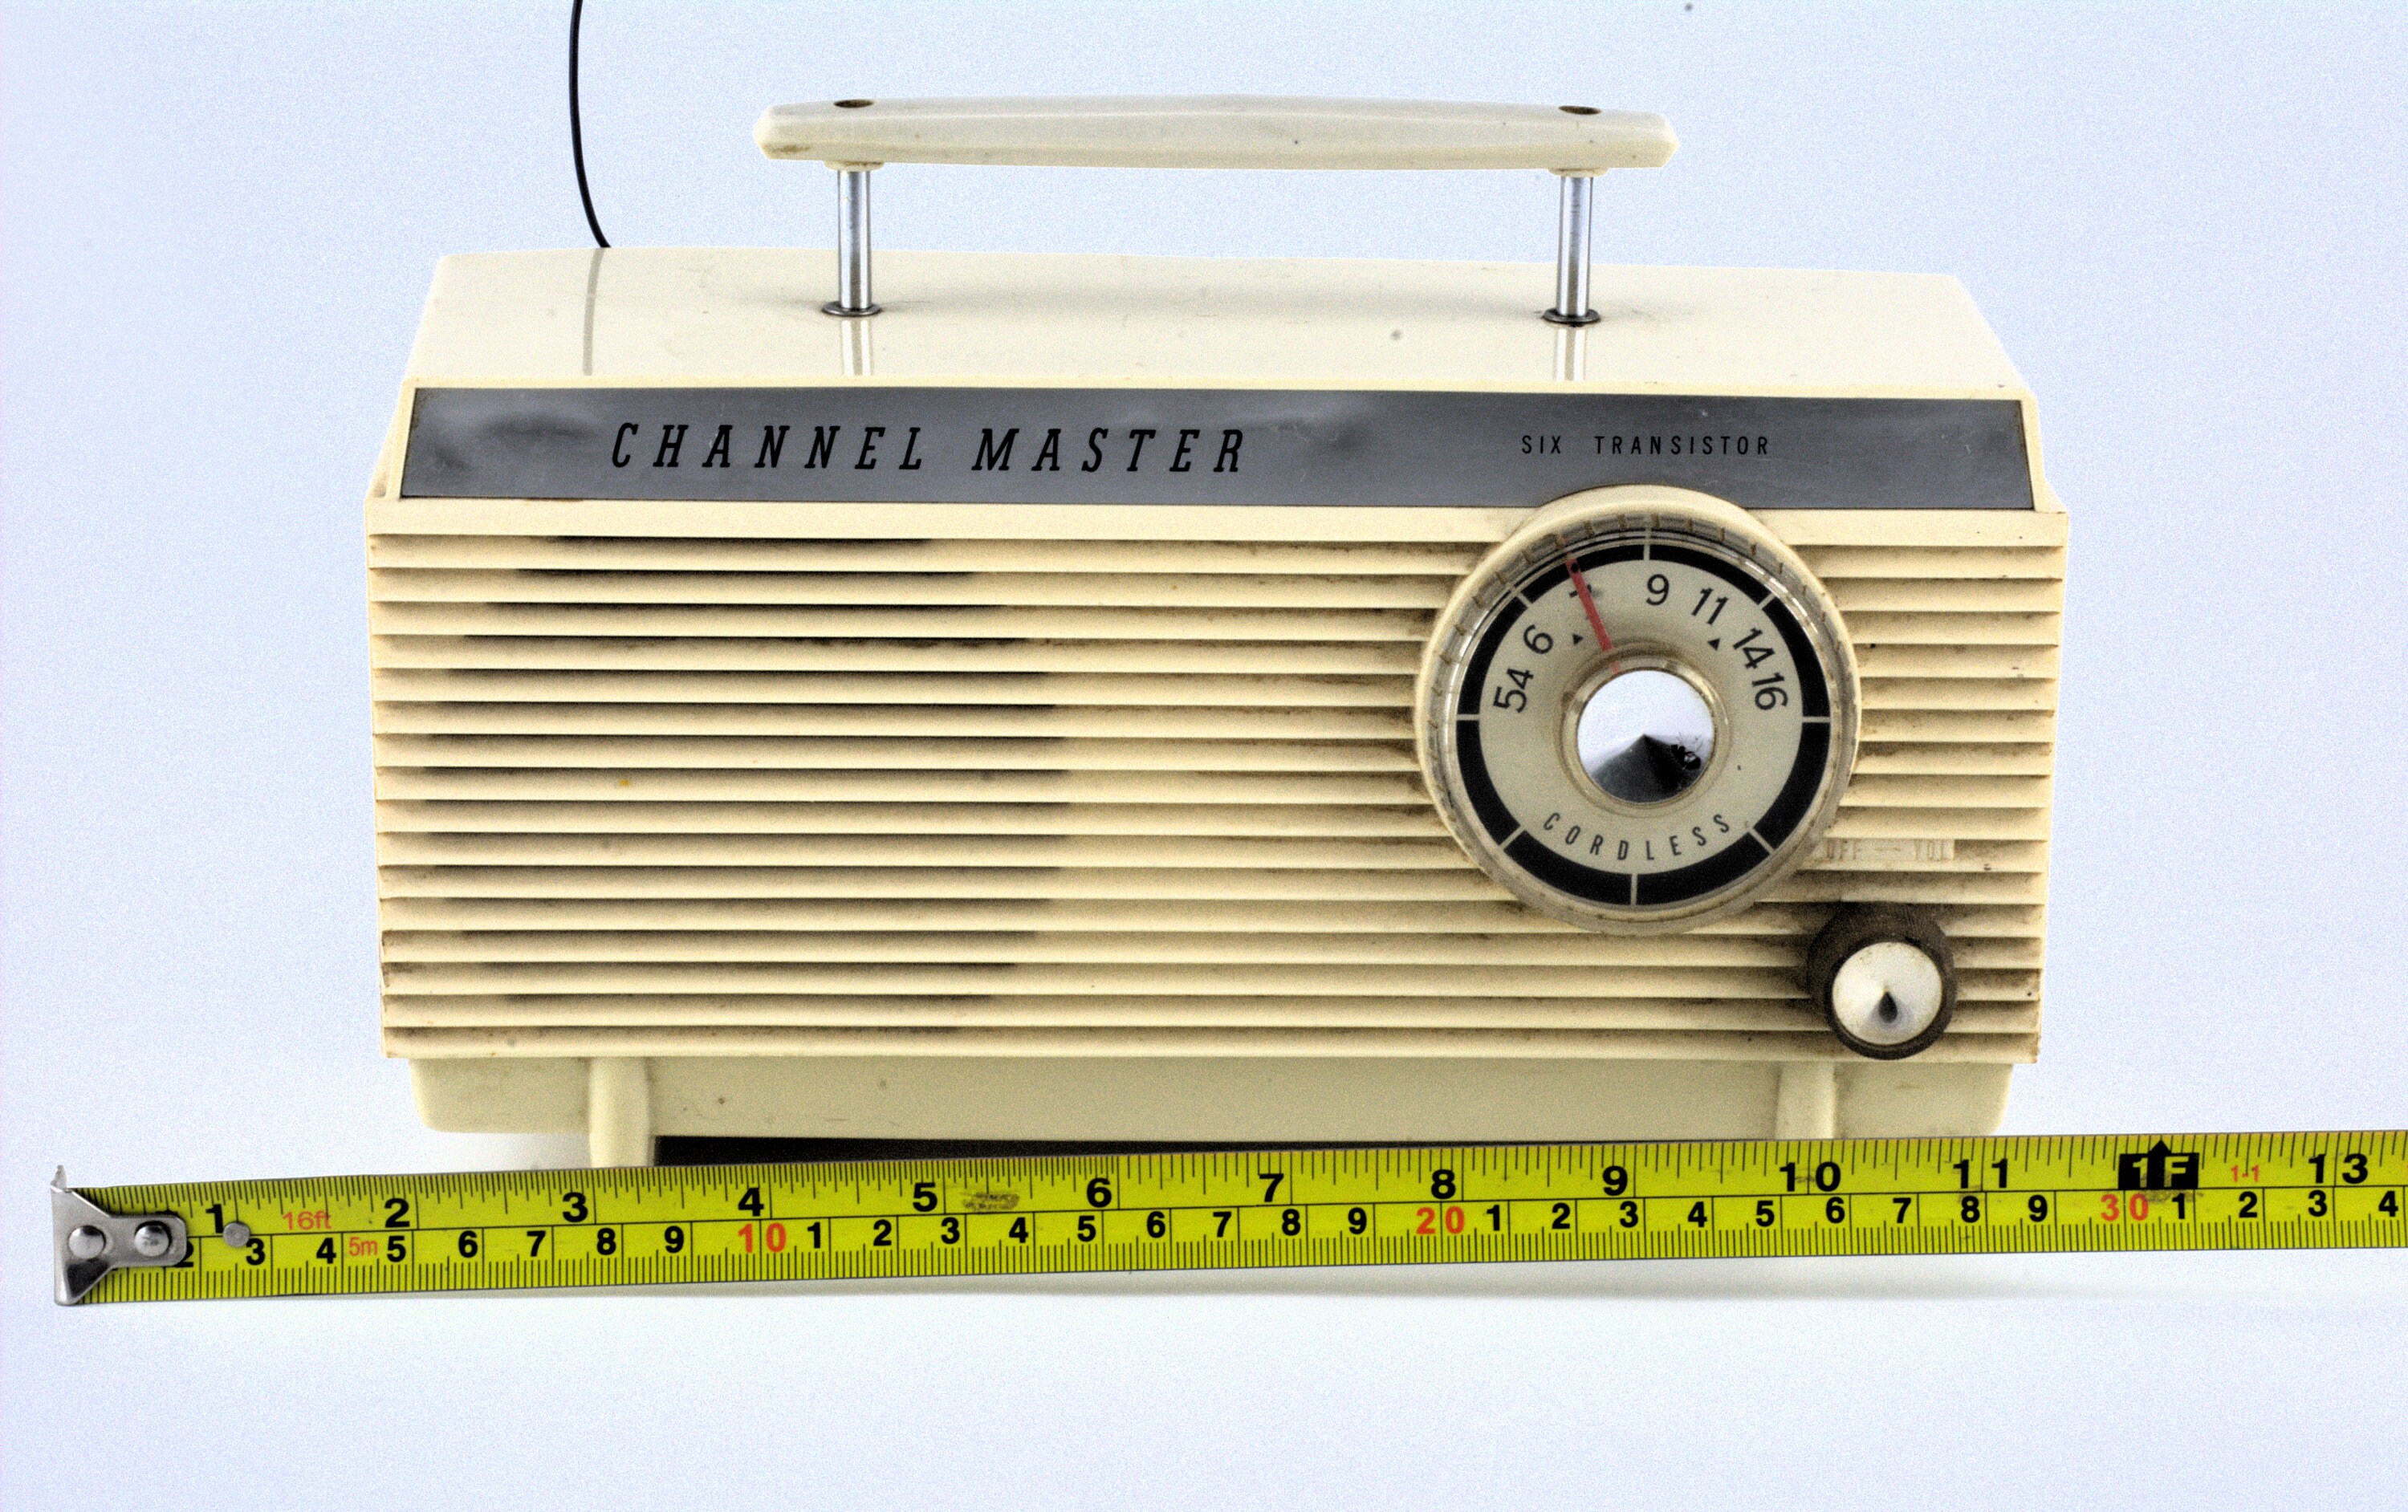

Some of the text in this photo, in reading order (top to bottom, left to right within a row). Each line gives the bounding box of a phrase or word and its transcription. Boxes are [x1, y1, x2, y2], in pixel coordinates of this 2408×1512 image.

[612, 422, 1244, 474] CHANNEL MASTER
[1522, 435, 1770, 455] SIX TRANSISTOR
[1646, 573, 1670, 606] 9
[1690, 587, 1730, 626] 11
[1523, 624, 1554, 654] 6
[1733, 628, 1775, 669] 14
[1493, 668, 1534, 713] 54
[1751, 673, 1788, 710] 16
[1543, 811, 1731, 861] CORDLESS
[205, 1204, 224, 1234] 1
[283, 1210, 332, 1230] 16ft
[384, 1197, 410, 1228] 2
[563, 1193, 588, 1222] 3
[738, 1188, 764, 1217] 4
[913, 1182, 938, 1212] 5
[1086, 1178, 1112, 1207] 6
[1259, 1173, 1284, 1202] 7
[1430, 1169, 1457, 1199] 8
[1602, 1166, 1629, 1196] 9
[1779, 1161, 1841, 1192] 10
[1953, 1159, 2008, 1189] 11
[2132, 1156, 2190, 1188] 1F
[2308, 1153, 2368, 1184] 13
[246, 1238, 265, 1266] 3
[316, 1237, 336, 1264] 4
[348, 1236, 378, 1257] 5m
[387, 1235, 406, 1262] 5
[458, 1230, 478, 1258] 6
[526, 1230, 547, 1258] 7
[596, 1228, 616, 1256] 8
[665, 1226, 684, 1254] 9
[738, 1223, 787, 1254] 10
[807, 1222, 822, 1249] 1
[872, 1220, 893, 1246] 2
[940, 1217, 961, 1245] 3
[1008, 1217, 1029, 1243] 4
[1076, 1215, 1096, 1243] 5
[1146, 1211, 1166, 1238] 6
[1213, 1211, 1232, 1238] 7
[1281, 1209, 1300, 1236] 8
[1348, 1207, 1367, 1234] 9
[1415, 1205, 1465, 1234] 20
[1486, 1205, 1501, 1231] 1
[1552, 1203, 1571, 1230] 2
[1619, 1201, 1639, 1228] 3
[1688, 1201, 1707, 1227] 4
[1755, 1199, 1775, 1227] 5
[1826, 1196, 1845, 1223] 6
[1892, 1197, 1912, 1224] 7
[1961, 1195, 1980, 1223] 8
[2028, 1194, 2048, 1222] 9
[2101, 1193, 2150, 1221] 30
[2172, 1193, 2185, 1219] 1
[2238, 1191, 2258, 1218] 2
[2308, 1189, 2328, 1217] 3
[2378, 1190, 2398, 1217] 4
